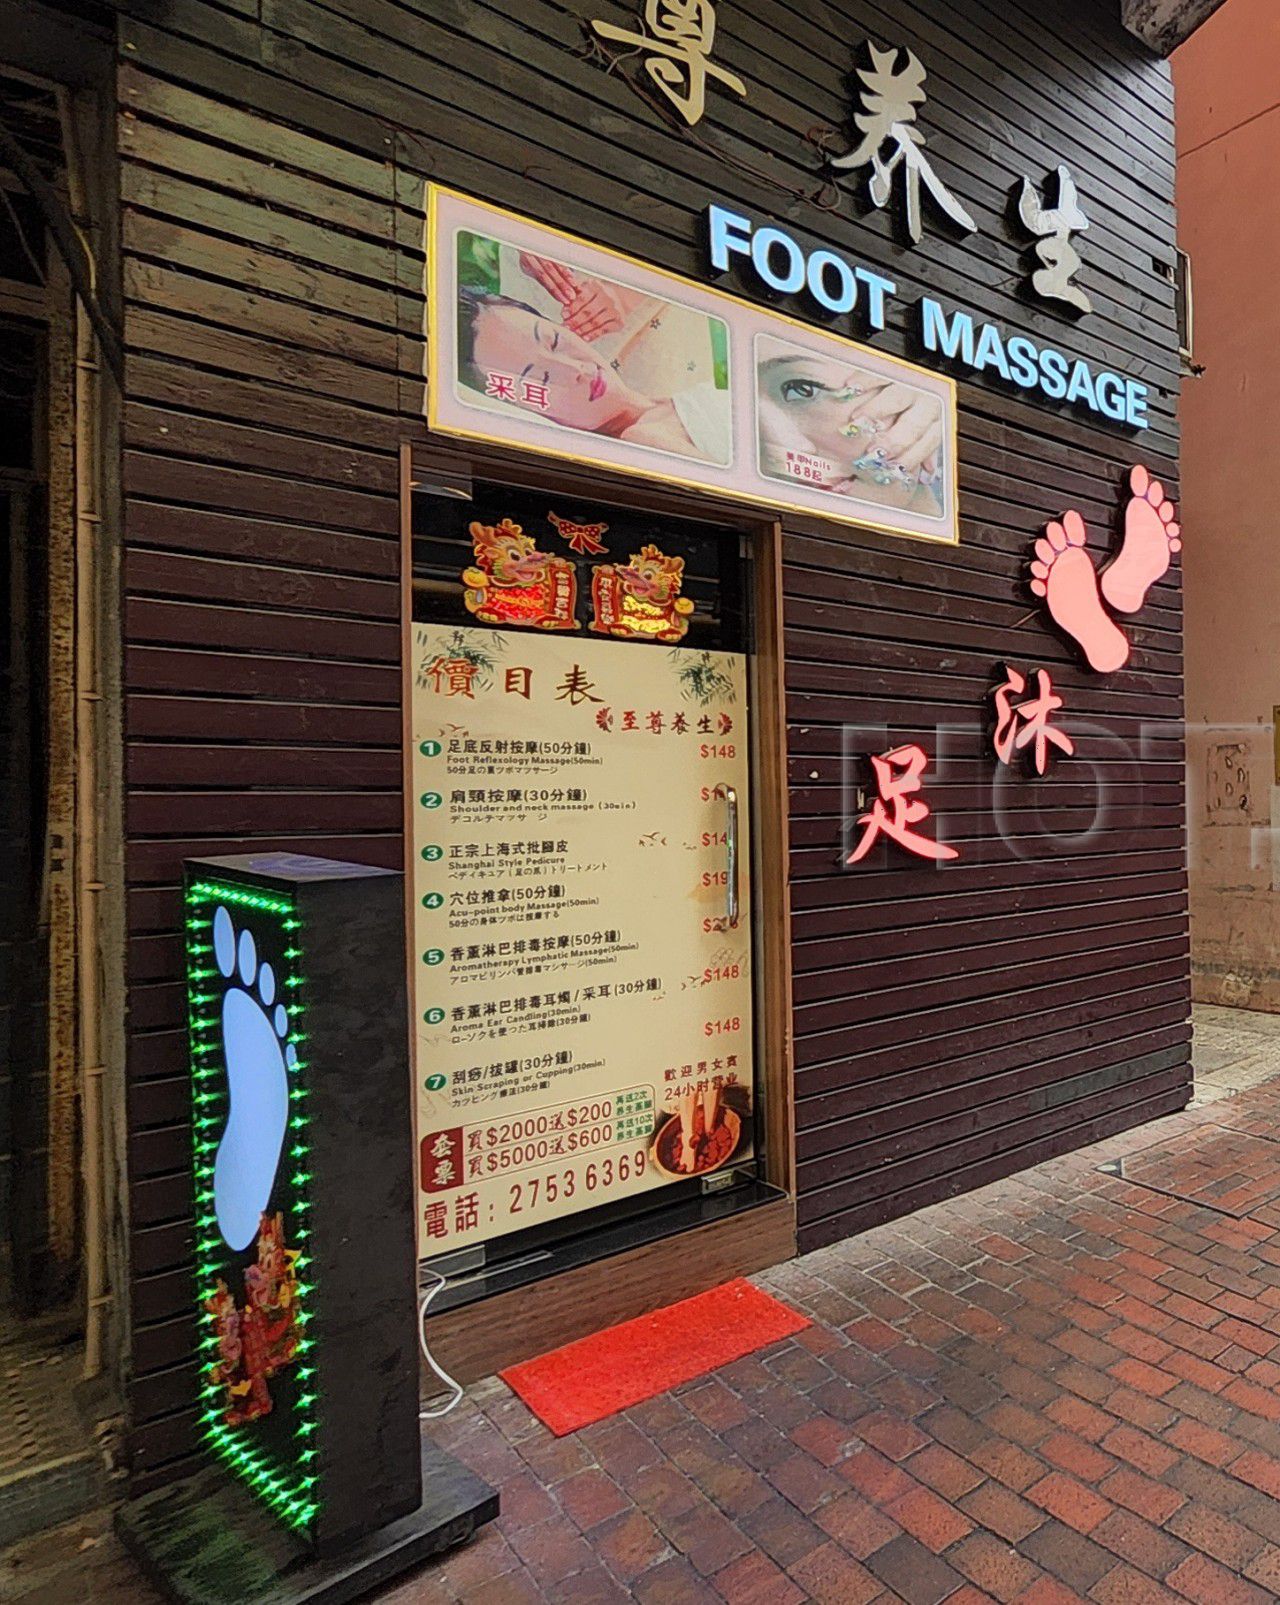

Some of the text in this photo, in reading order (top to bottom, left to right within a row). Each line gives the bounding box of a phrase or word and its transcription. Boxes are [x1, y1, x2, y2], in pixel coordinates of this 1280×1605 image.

[708, 204, 1150, 430] FOOT MASSAGE
[486, 372, 549, 410] 采耳
[427, 656, 605, 706] 價目表
[620, 709, 716, 736] 至尊養生
[422, 741, 440, 756] 1
[701, 744, 736, 759] $148
[446, 756, 470, 765] Foot
[473, 756, 529, 766] Reflexology
[423, 793, 440, 808] 2
[450, 804, 500, 813] Shoulder
[502, 804, 523, 812] and
[524, 803, 549, 812] neck
[551, 803, 594, 812] massage
[702, 831, 729, 848] $14
[424, 846, 441, 860] 3
[448, 856, 565, 871] Shanghai Style Pedicure
[702, 870, 729, 888] $19
[424, 893, 442, 908] 4
[448, 906, 500, 918] Acu-point
[501, 904, 526, 915] body
[425, 950, 443, 965] 5
[449, 957, 520, 974] Aromatherapy
[521, 951, 569, 966] Lymphatic
[703, 964, 740, 982] $148
[425, 1009, 444, 1023] 6
[450, 1021, 484, 1034] Aroma
[486, 1018, 503, 1028] Ear
[704, 1017, 741, 1036] $148
[427, 1075, 445, 1090] 7
[451, 1086, 474, 1098] Skin
[476, 1077, 520, 1093] Scraping
[523, 1073, 533, 1082] or
[509, 1168, 576, 1215] 2753
[585, 1149, 647, 1193] 6369
